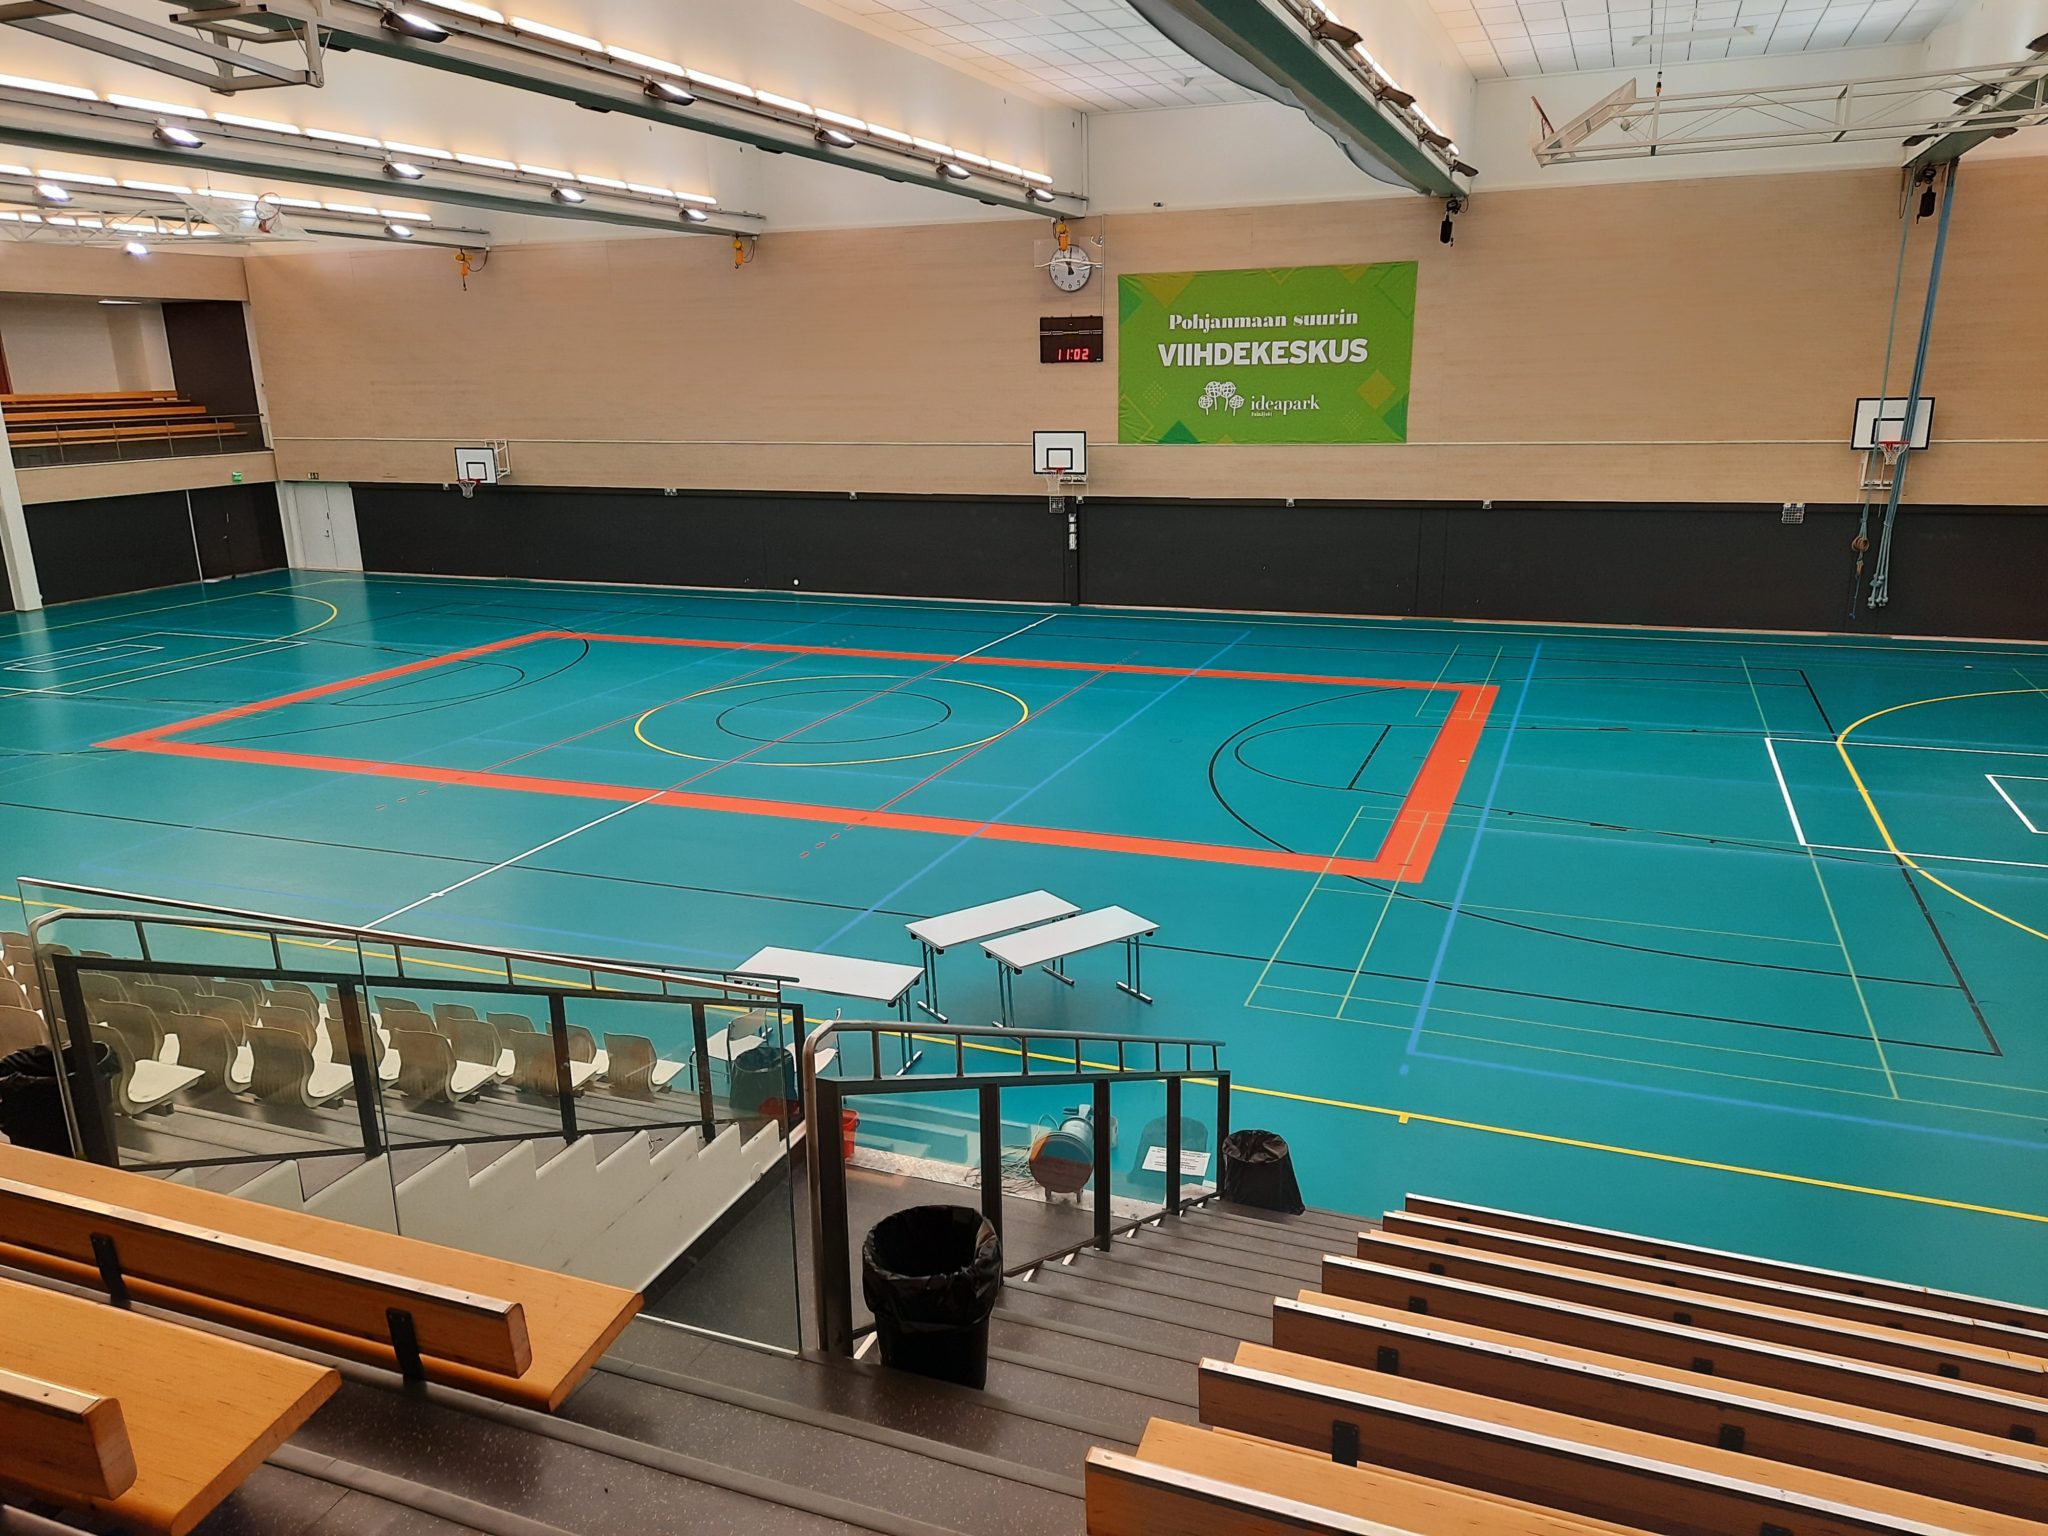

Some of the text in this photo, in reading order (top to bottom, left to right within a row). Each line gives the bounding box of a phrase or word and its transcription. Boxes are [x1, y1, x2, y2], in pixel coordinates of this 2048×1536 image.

[1169, 308, 1358, 333] Pohjanmaan suurin
[1058, 348, 1089, 361] 11:02
[1158, 338, 1369, 367] VIIHDEKESKUS
[1251, 394, 1320, 416] ideapark
